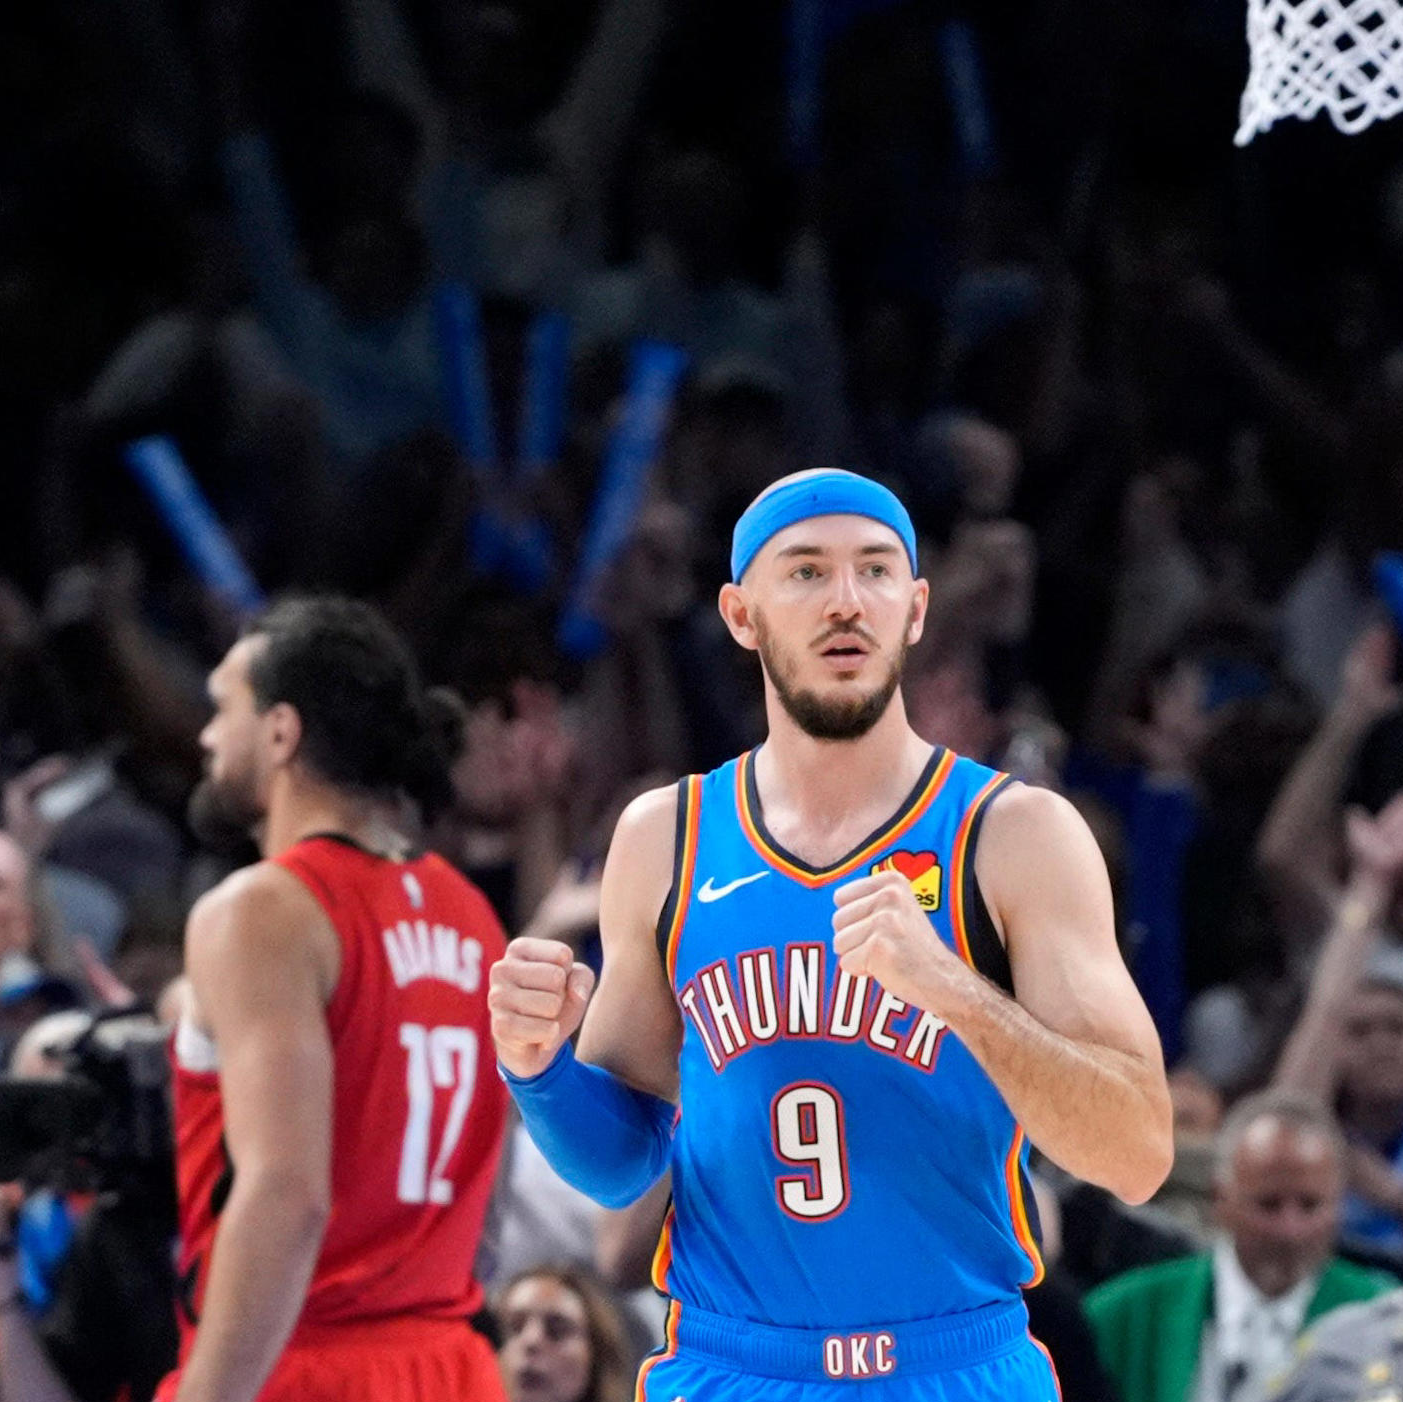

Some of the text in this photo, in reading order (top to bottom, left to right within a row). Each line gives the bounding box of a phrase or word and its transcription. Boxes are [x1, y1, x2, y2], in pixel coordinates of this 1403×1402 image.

[678, 942, 948, 1075] THUNDER
[398, 1021, 479, 1205] 12
[770, 1080, 851, 1223] 9
[823, 1331, 897, 1380] OKC
